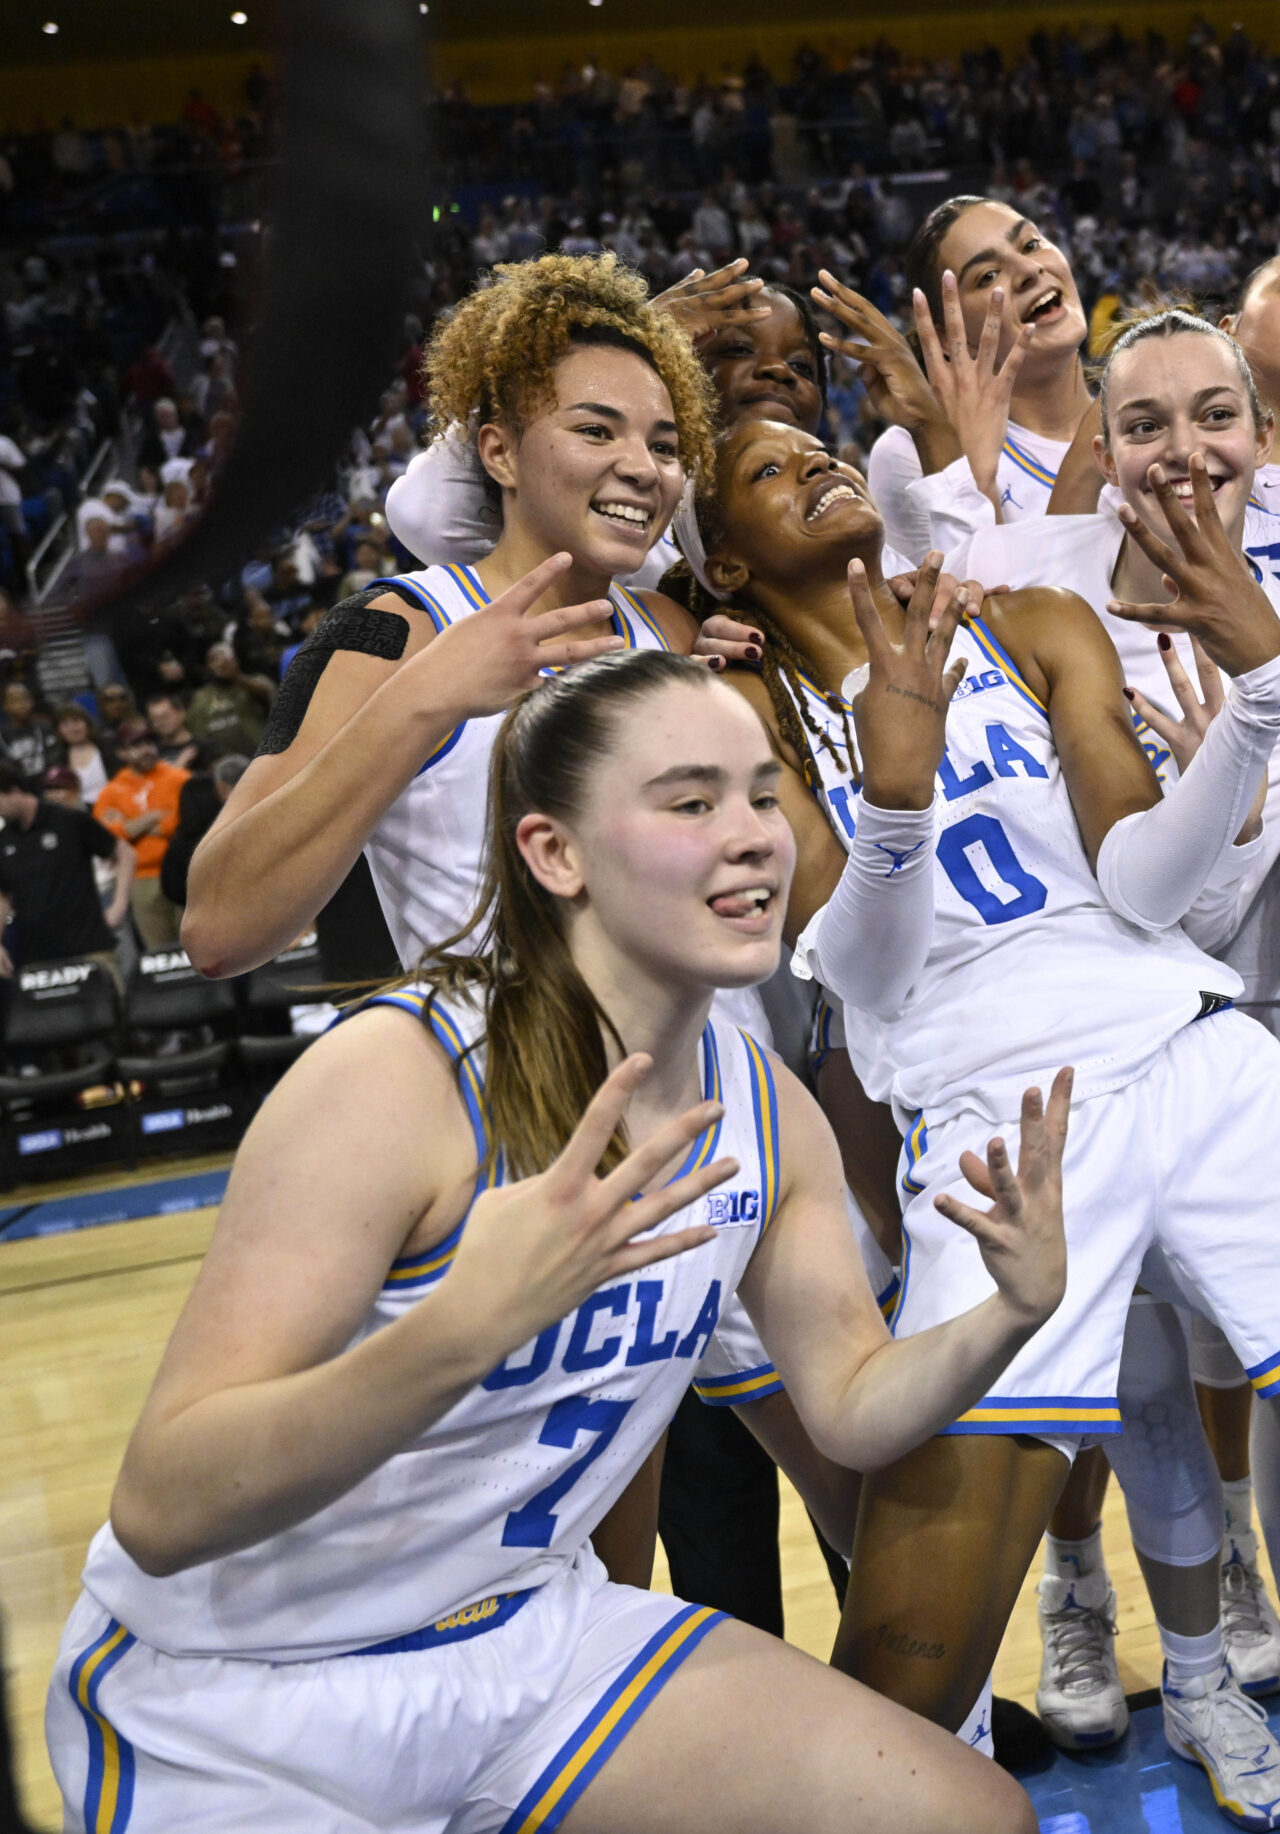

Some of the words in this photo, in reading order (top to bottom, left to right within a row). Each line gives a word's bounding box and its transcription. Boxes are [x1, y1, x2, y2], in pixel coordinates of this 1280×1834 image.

[828, 724, 1049, 839] ULA
[936, 812, 1048, 925] 0
[140, 951, 190, 975] REA
[501, 1395, 638, 1548] 7
